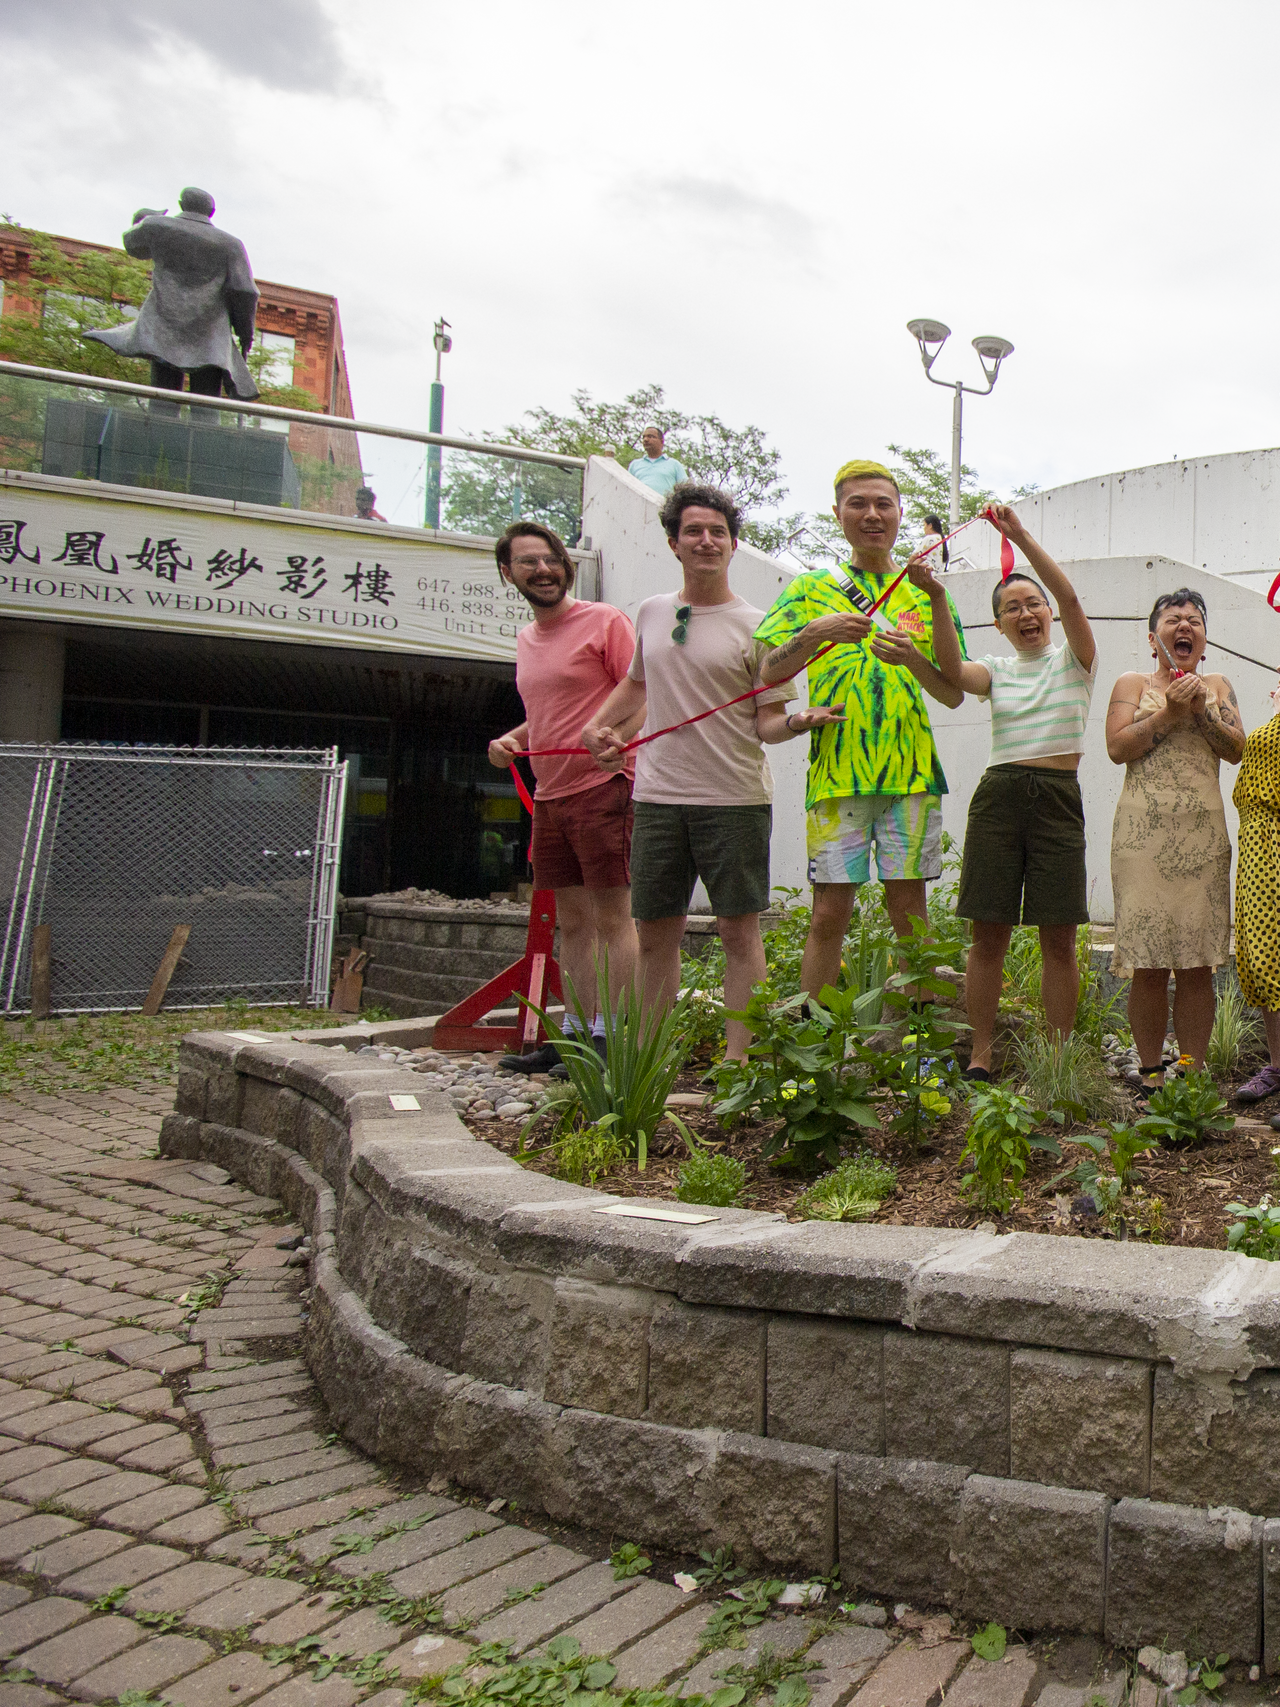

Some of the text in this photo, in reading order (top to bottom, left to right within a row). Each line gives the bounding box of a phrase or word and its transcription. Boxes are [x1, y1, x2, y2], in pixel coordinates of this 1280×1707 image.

[146, 590, 288, 620] WEDDING
[297, 606, 399, 631] STUDIO
[898, 611, 920, 622] MARS
[444, 617, 487, 635] Unit
[897, 622, 925, 634] ATTACKS
